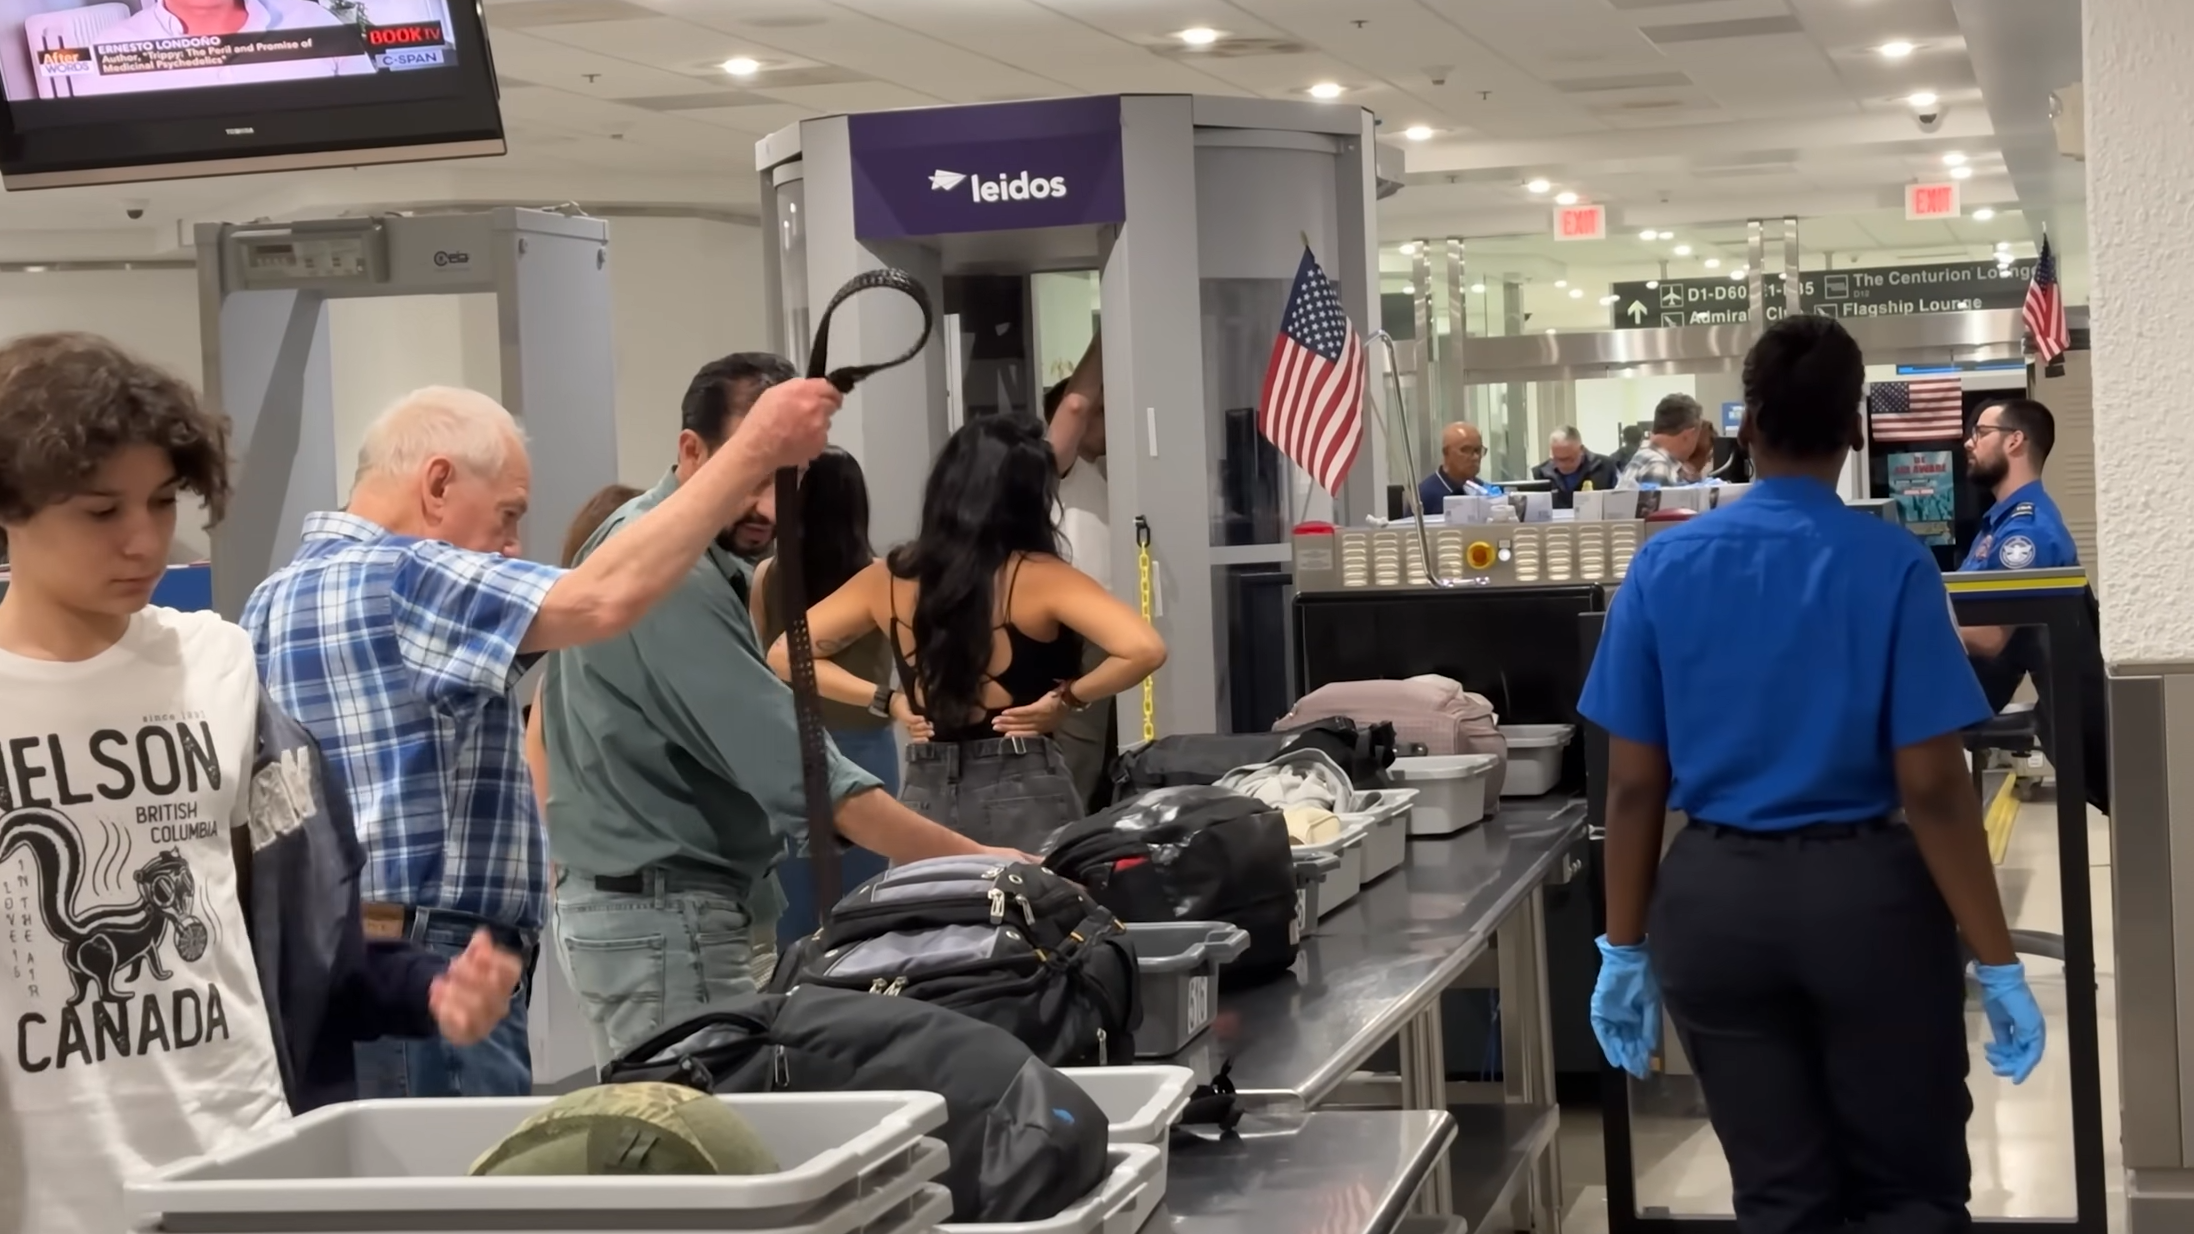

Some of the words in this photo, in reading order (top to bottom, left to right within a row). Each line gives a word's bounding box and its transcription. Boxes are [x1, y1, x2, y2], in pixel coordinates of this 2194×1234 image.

[97, 42, 153, 55] ERNESTO
[155, 36, 221, 50] LONDOÑO
[369, 26, 421, 45] BOOK
[424, 28, 440, 39] TV
[43, 51, 79, 65] After
[102, 54, 141, 64] Author,
[186, 48, 206, 57] The
[208, 44, 231, 55] Peril
[234, 43, 254, 53] and
[256, 40, 299, 51] Promise
[300, 37, 312, 48] of
[45, 62, 89, 74] WORDS
[103, 60, 154, 73] Medicinal
[970, 170, 1067, 203] leidos
[1916, 187, 1952, 214] EXIT
[1564, 210, 1597, 236] EXIT
[1853, 273, 1884, 287] The
[1888, 268, 1972, 285] Centurion
[1977, 265, 2037, 281] Long
[1689, 308, 1750, 325] Admiral
[1843, 299, 1914, 317] Flagship
[142, 713, 175, 722] since
[136, 801, 198, 824] BRITISH
[151, 821, 218, 844] COLUMBIA
[18, 983, 229, 1073] CANADA
